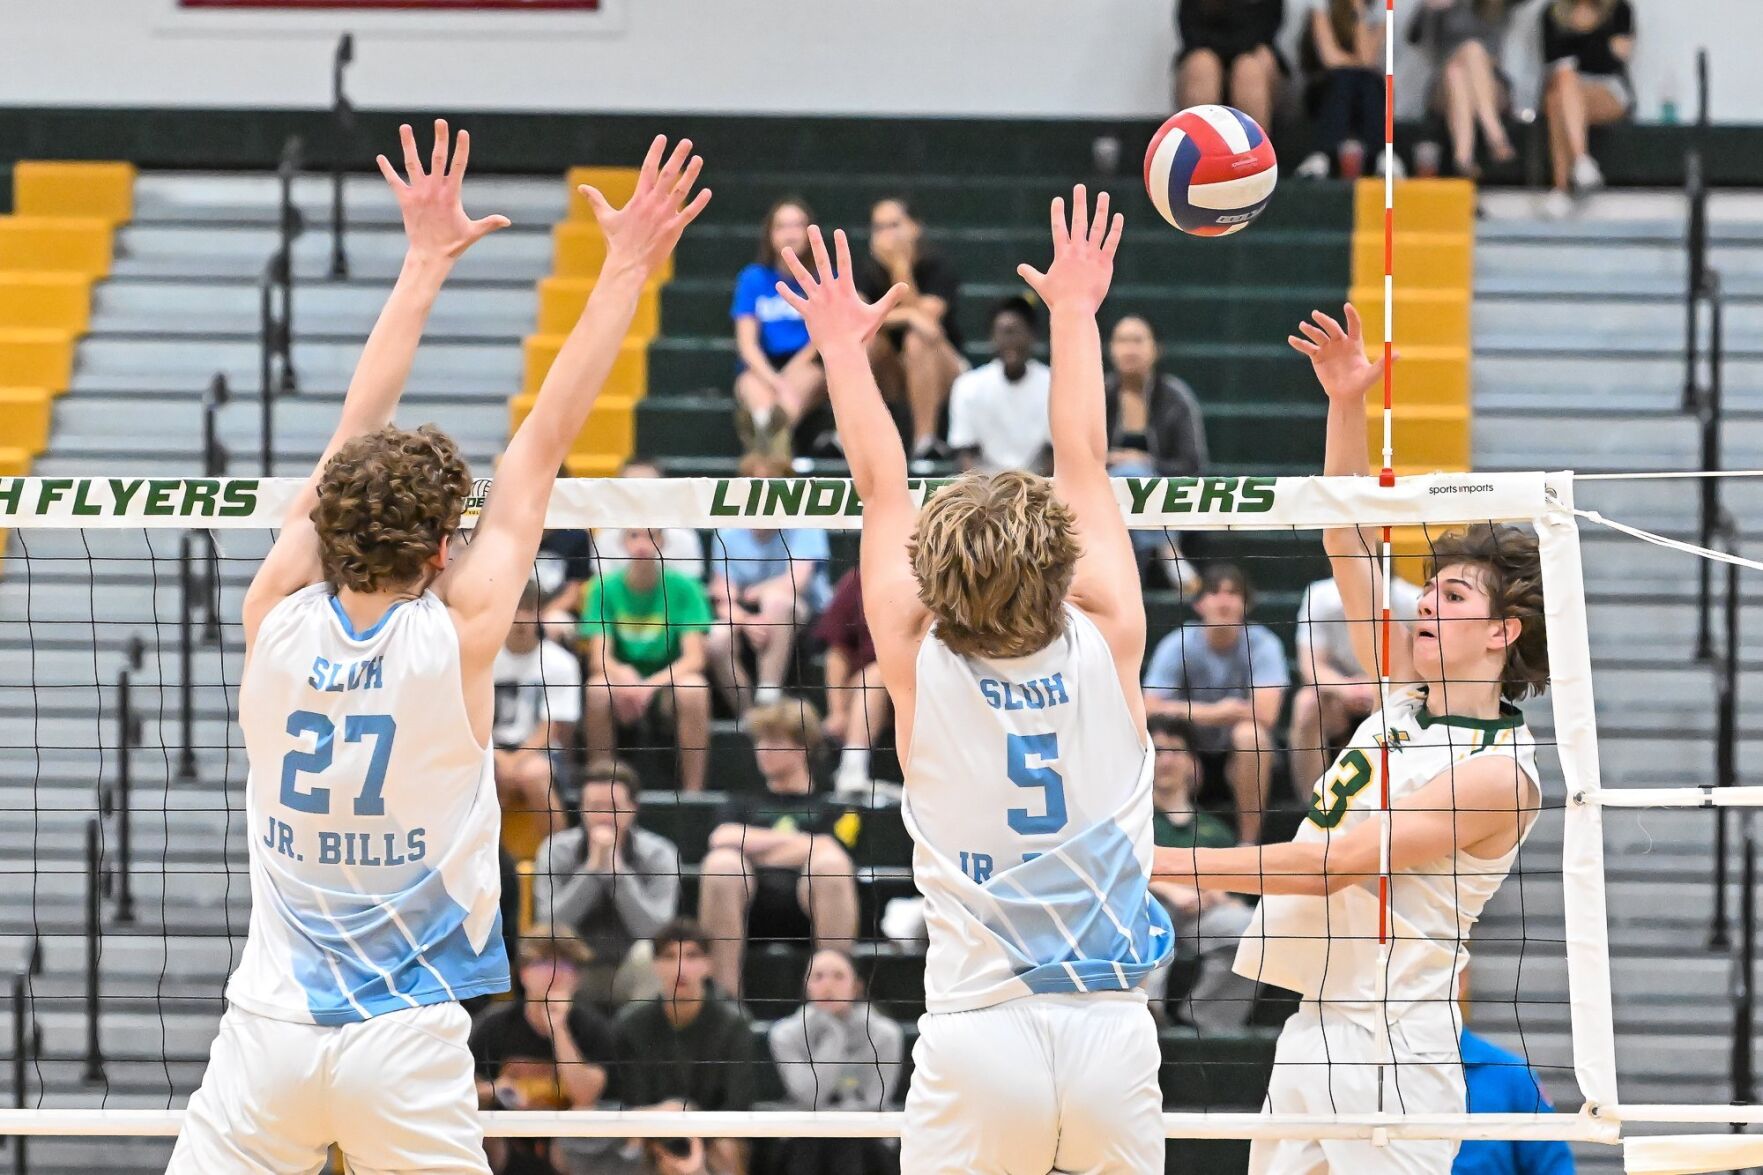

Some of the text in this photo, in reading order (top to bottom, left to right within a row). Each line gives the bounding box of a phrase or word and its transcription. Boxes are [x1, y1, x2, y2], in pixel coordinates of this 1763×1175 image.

[35, 478, 259, 517] FLYERS
[709, 477, 1278, 516] LIND YERS
[1428, 483, 1494, 496] sports imports
[979, 672, 1070, 711] SLUH
[279, 709, 397, 816] 27
[1006, 732, 1068, 836] 5
[263, 816, 426, 867] JR. BILLS
